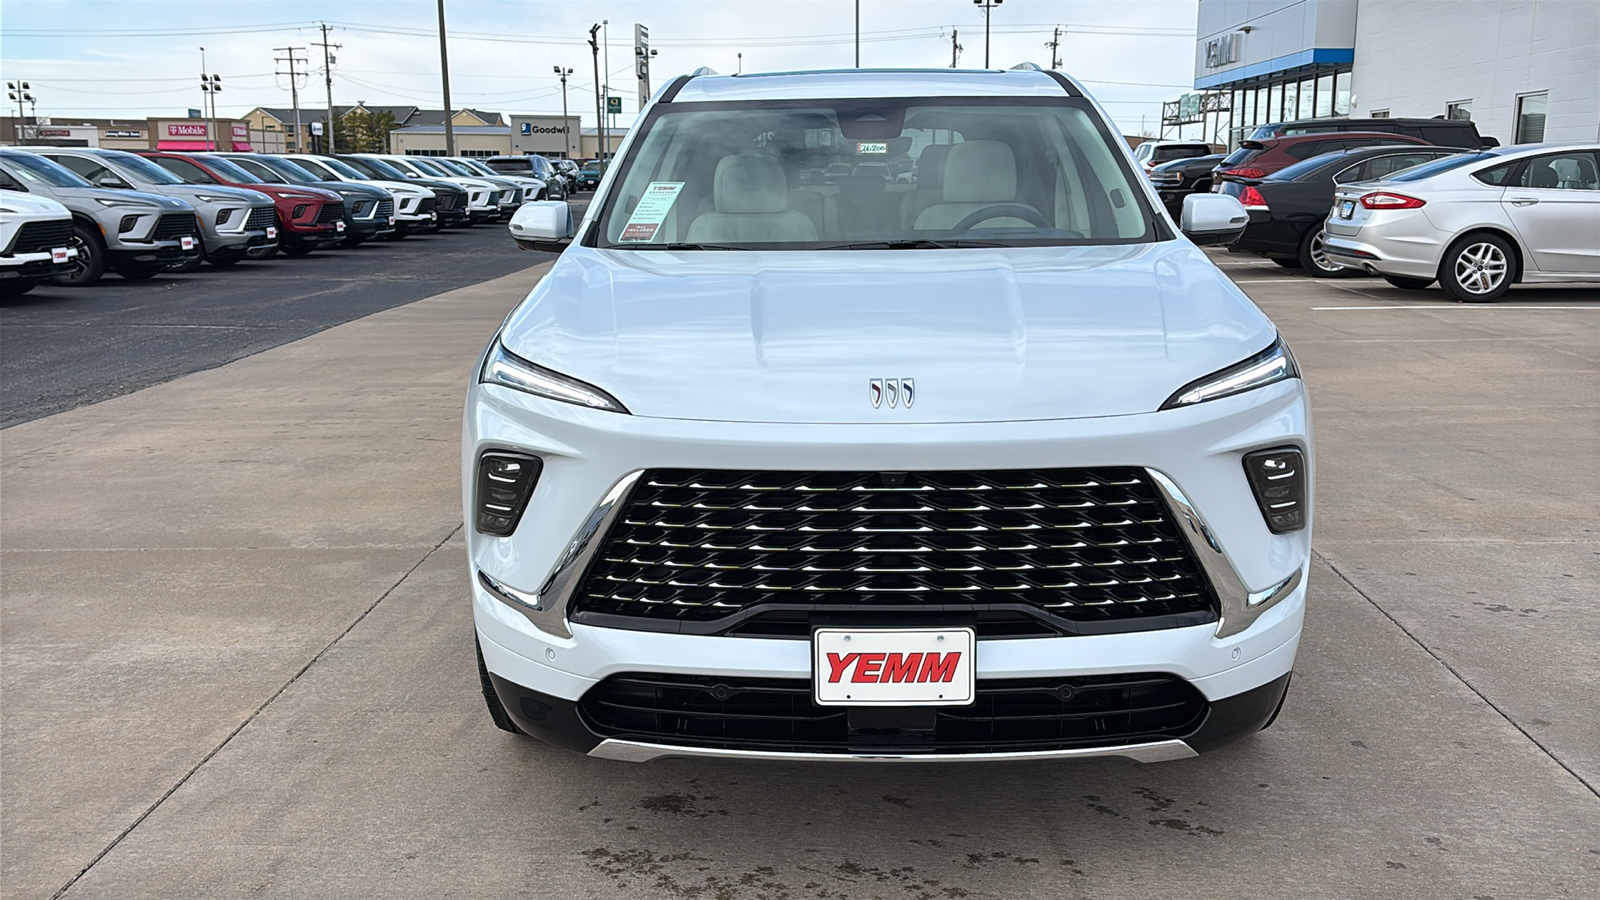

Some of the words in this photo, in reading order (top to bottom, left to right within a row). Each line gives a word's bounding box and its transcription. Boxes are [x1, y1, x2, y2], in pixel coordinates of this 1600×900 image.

[178, 125, 205, 135] Mobile
[532, 125, 570, 134] Goodwil
[826, 652, 962, 683] YEMM
